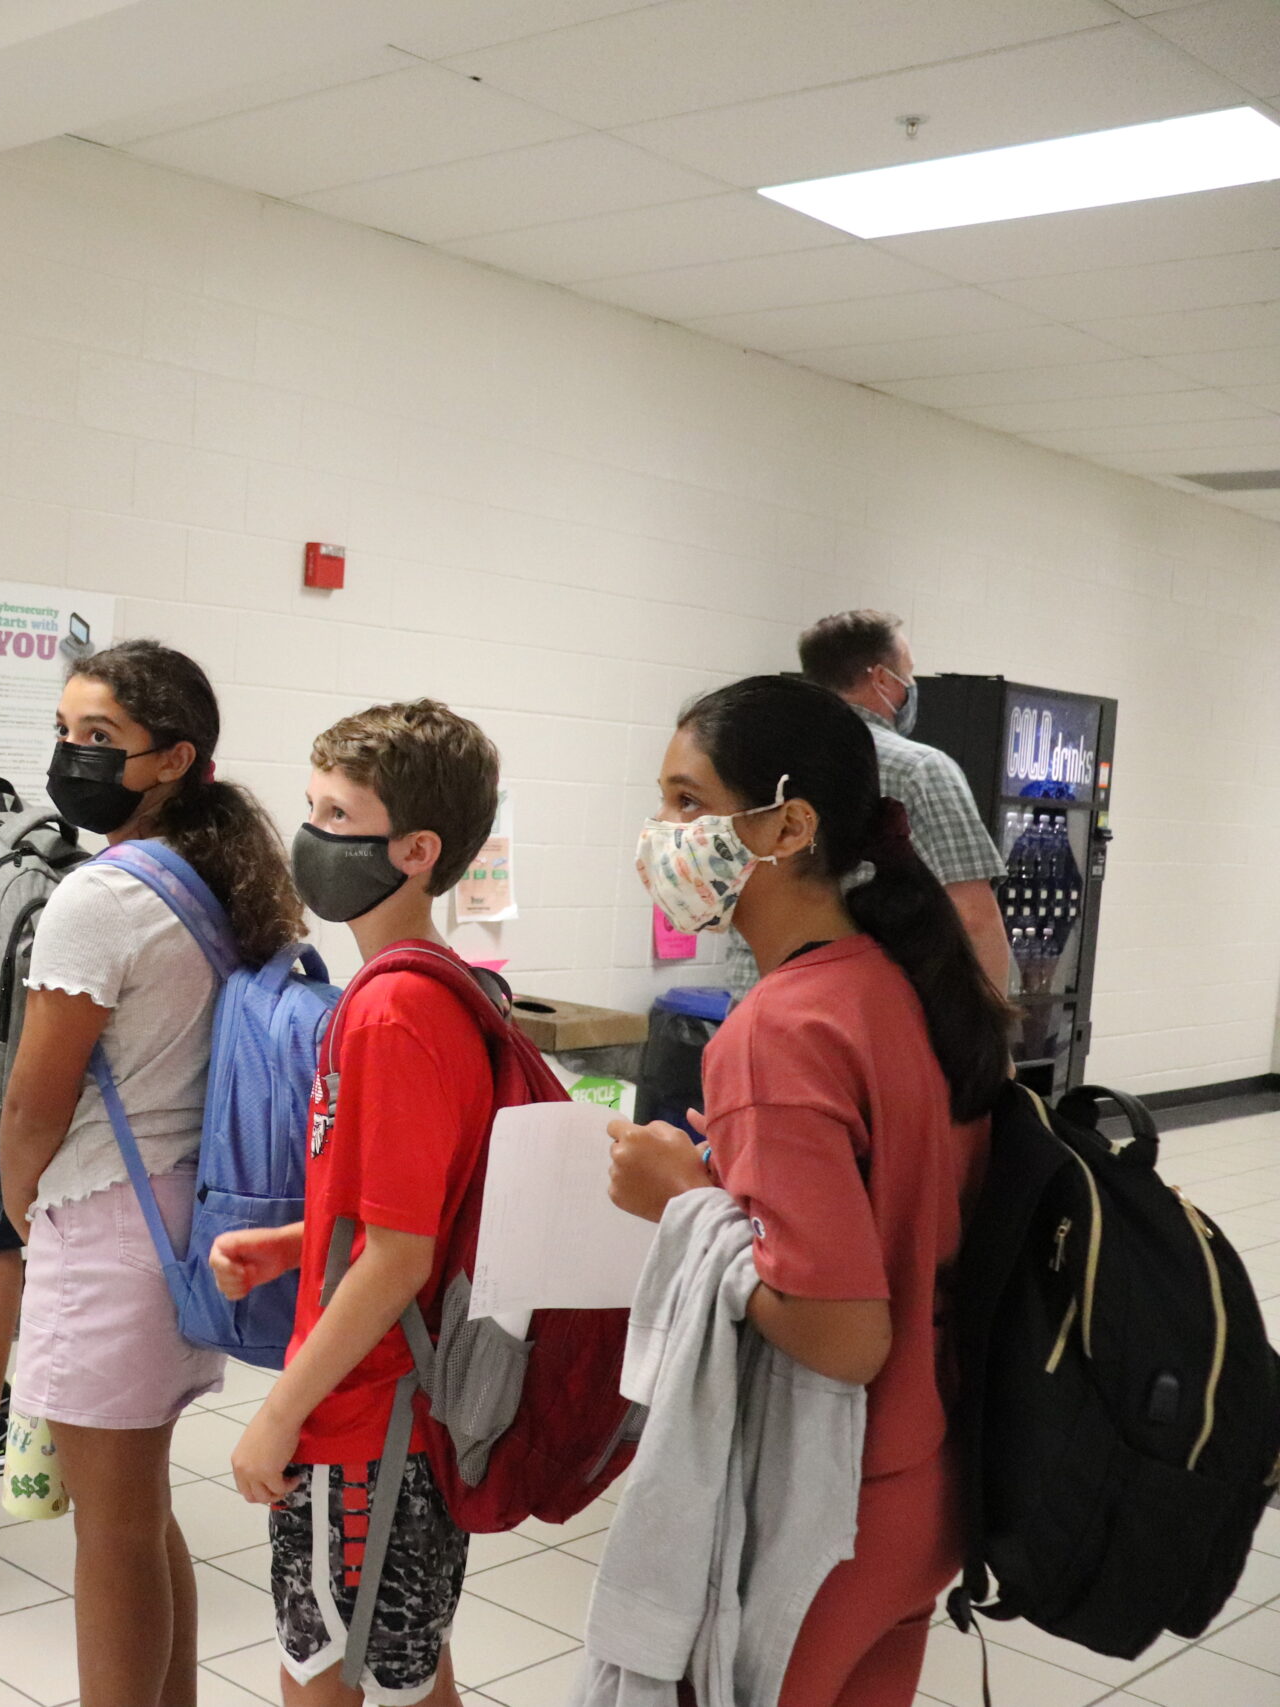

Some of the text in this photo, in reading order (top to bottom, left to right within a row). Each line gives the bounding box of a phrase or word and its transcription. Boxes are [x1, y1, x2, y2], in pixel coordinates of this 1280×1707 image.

[31, 618, 59, 632] with
[1007, 706, 1094, 785] COLD drinks
[572, 1085, 616, 1104] RECYCLE
